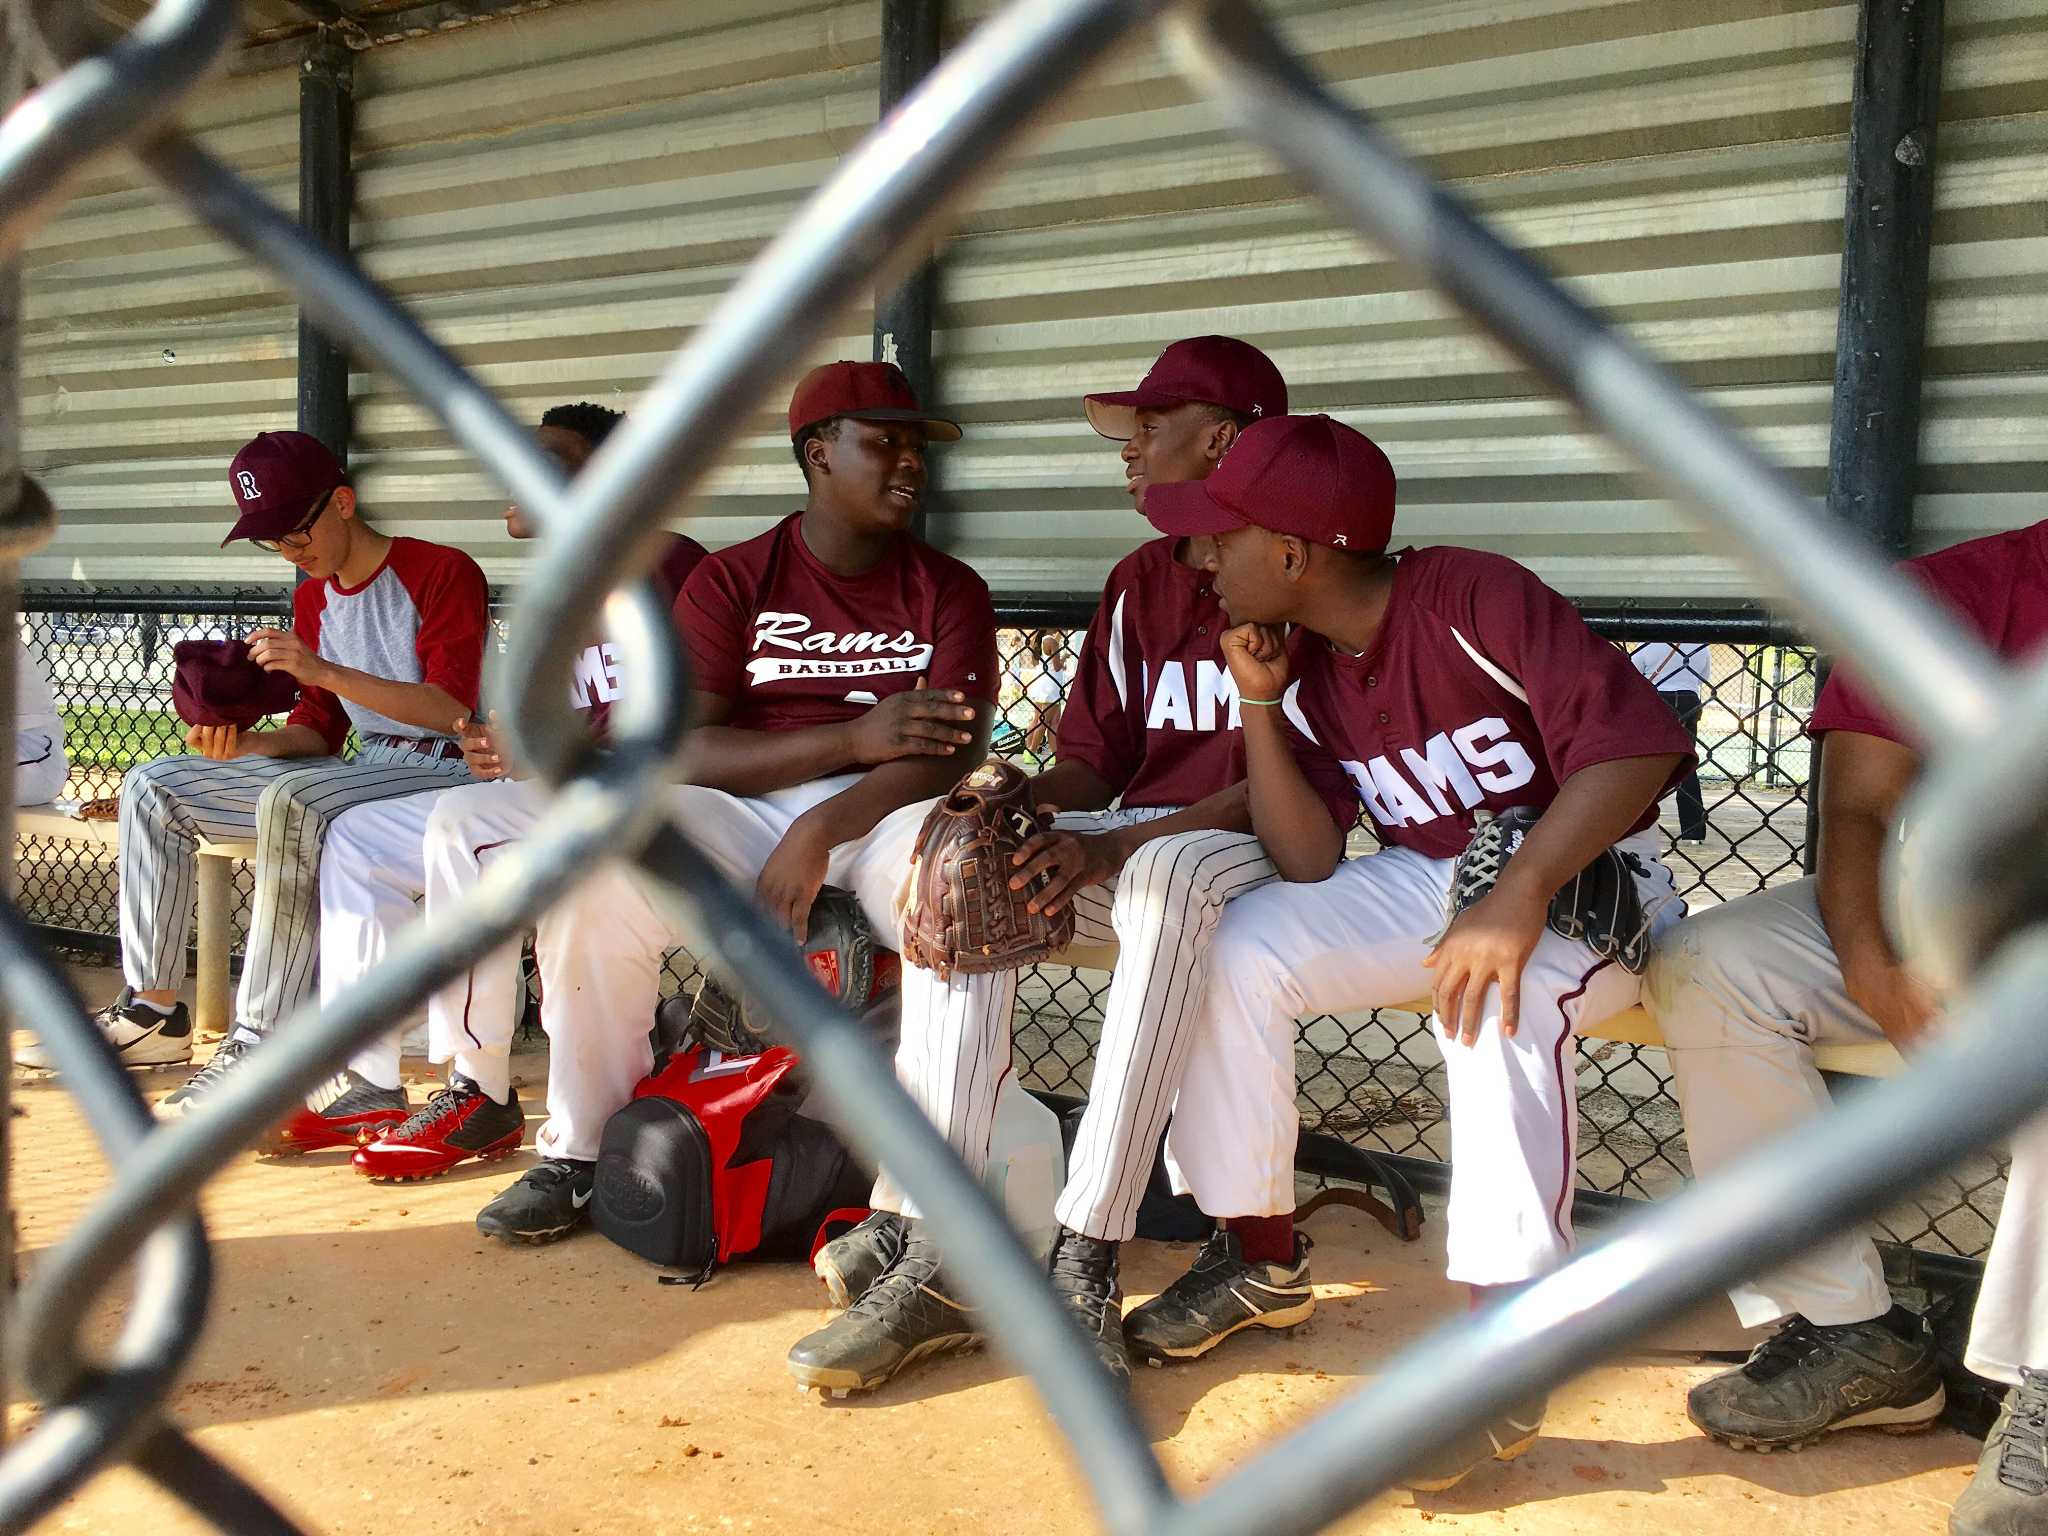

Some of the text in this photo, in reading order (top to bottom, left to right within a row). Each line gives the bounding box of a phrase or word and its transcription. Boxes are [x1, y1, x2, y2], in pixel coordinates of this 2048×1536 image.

[237, 471, 262, 500] R
[752, 611, 920, 654] Rams
[778, 660, 917, 674] BASEBALL
[1142, 660, 1243, 732] AM
